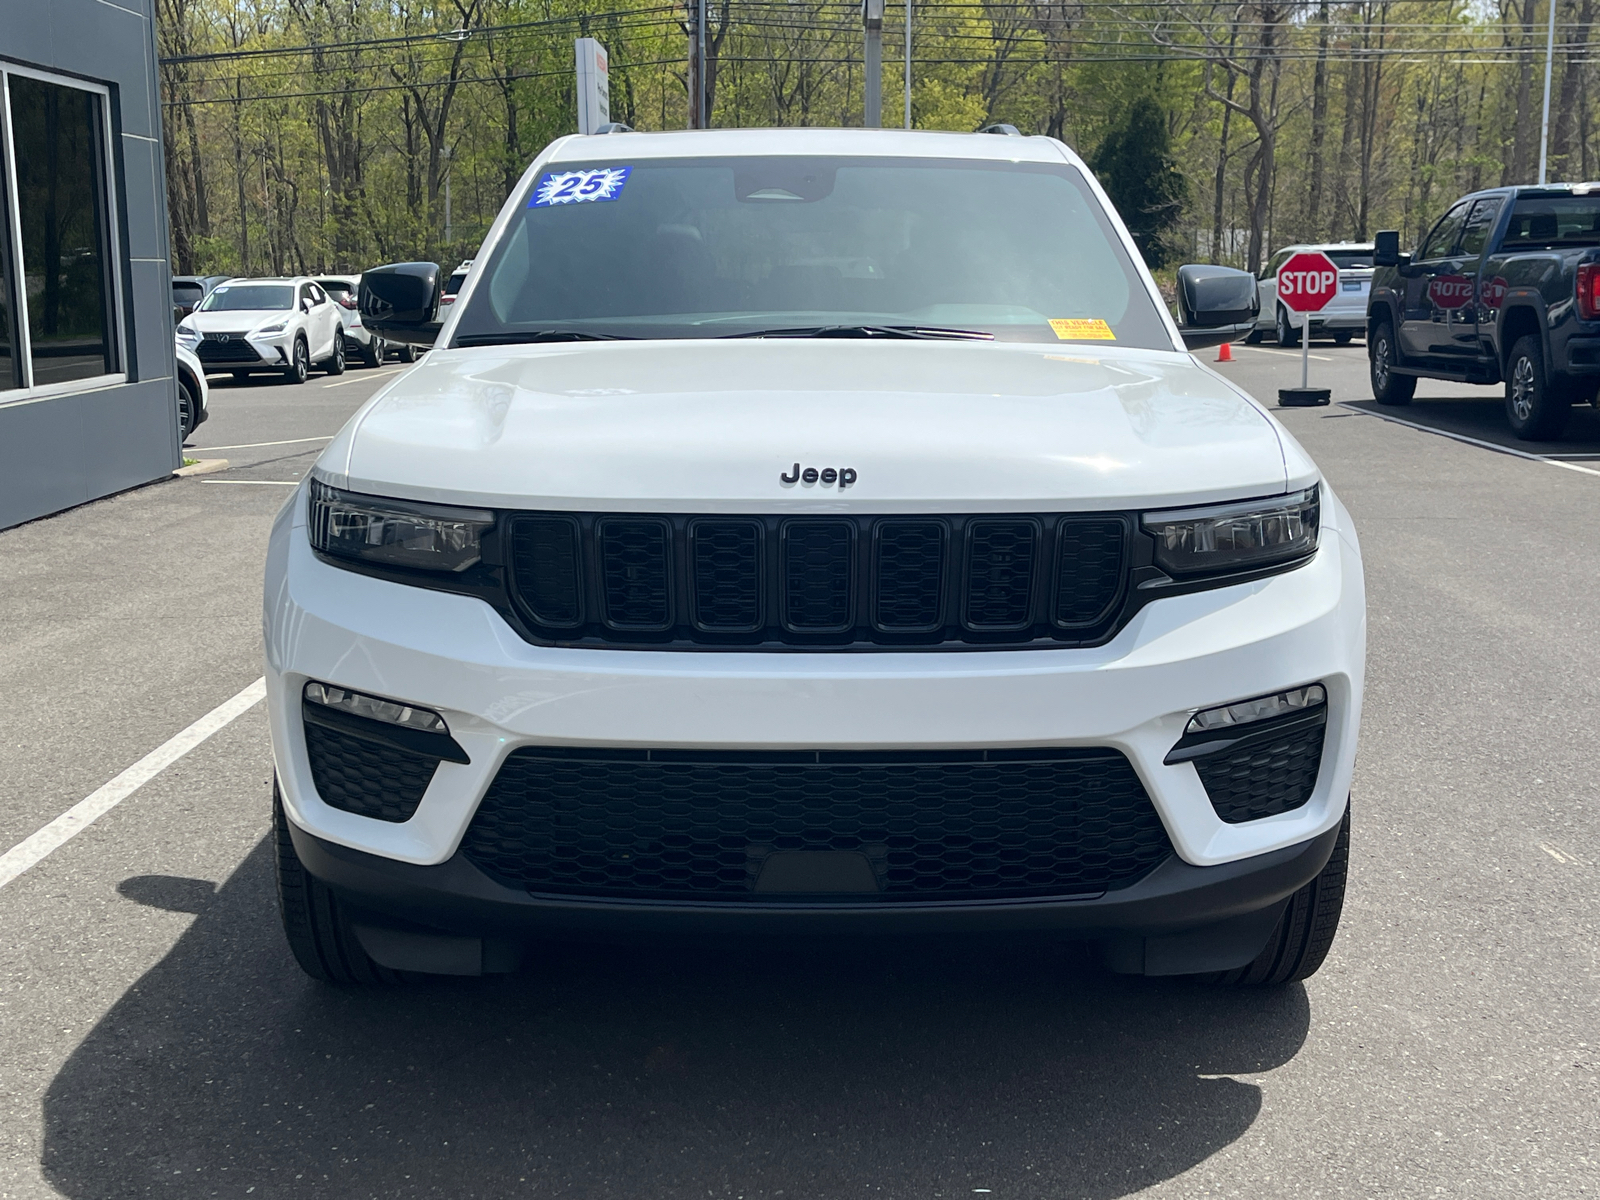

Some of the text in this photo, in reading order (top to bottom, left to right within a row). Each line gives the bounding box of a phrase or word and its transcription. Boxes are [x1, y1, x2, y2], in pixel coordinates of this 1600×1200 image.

[552, 174, 606, 198] 25
[1280, 271, 1335, 295] STOP
[781, 462, 857, 488] Jeep
